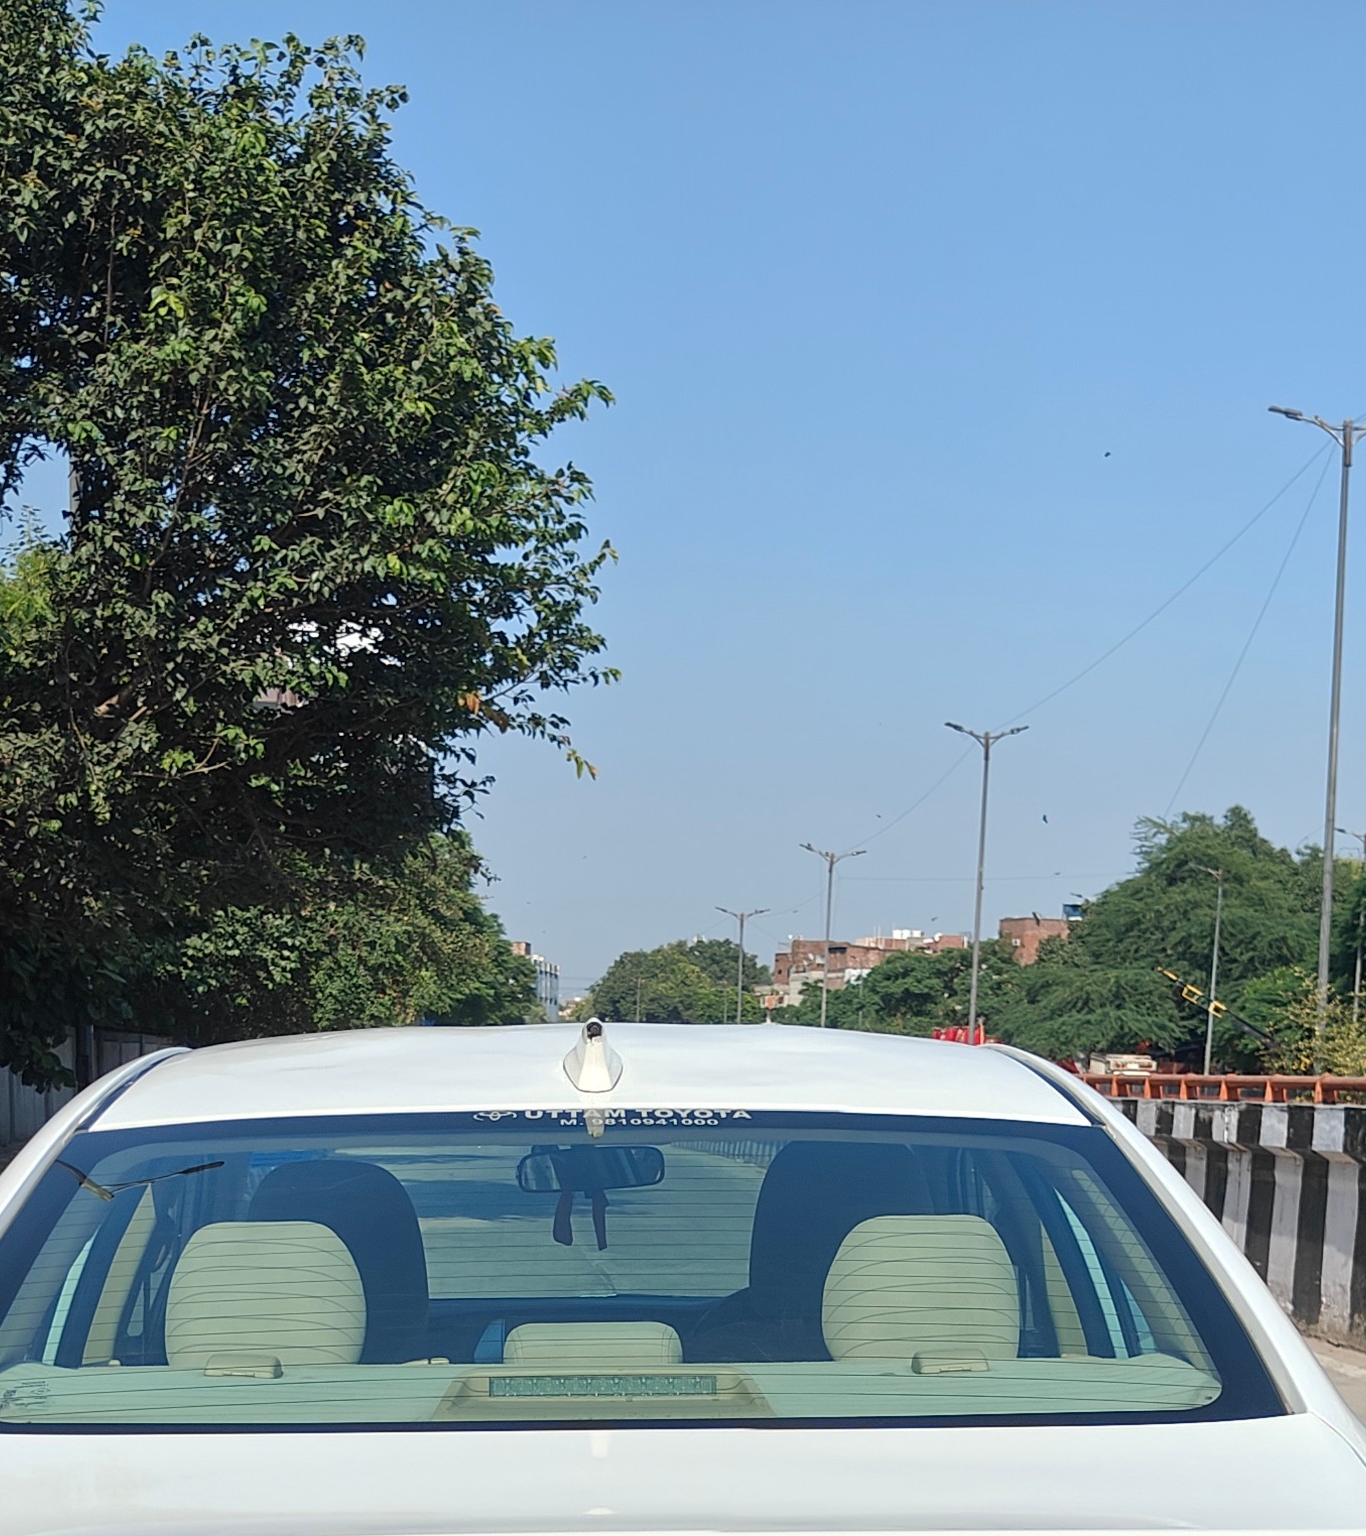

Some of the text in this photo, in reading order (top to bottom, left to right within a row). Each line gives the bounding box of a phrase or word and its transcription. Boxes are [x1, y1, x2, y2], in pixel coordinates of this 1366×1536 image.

[524, 1109, 752, 1119] UTTAM TOYOTA
[591, 1118, 719, 1126] 9810941000
